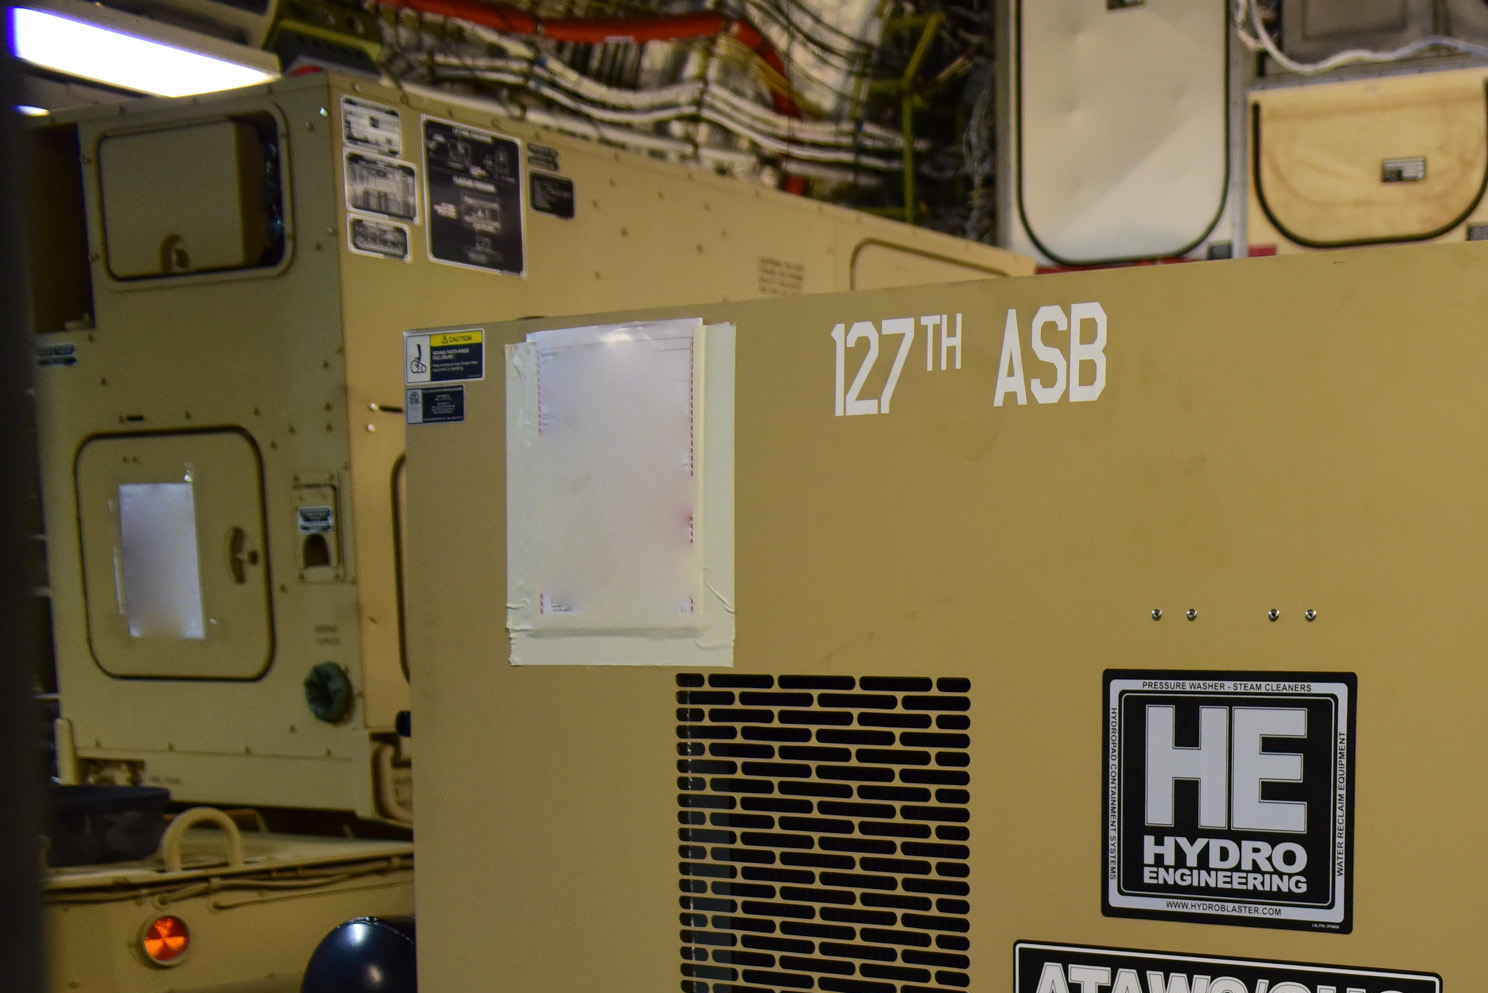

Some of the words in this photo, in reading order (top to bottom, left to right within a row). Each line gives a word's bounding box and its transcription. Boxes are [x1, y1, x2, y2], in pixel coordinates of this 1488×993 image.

[831, 313, 962, 417] 127TH
[994, 302, 1108, 406] ASB
[1142, 682, 1187, 690] PRESSURE
[1189, 682, 1225, 691] WASHER
[1233, 683, 1262, 691] STEAM
[1264, 683, 1312, 692] CLEANERS
[1145, 704, 1308, 834] HE
[1338, 732, 1346, 791] EQUIPMENT
[1144, 835, 1308, 873] HYDRO
[1144, 867, 1308, 893] ENGINEERING
[1166, 900, 1282, 916] WWW.HYDROBLASTER.COM
